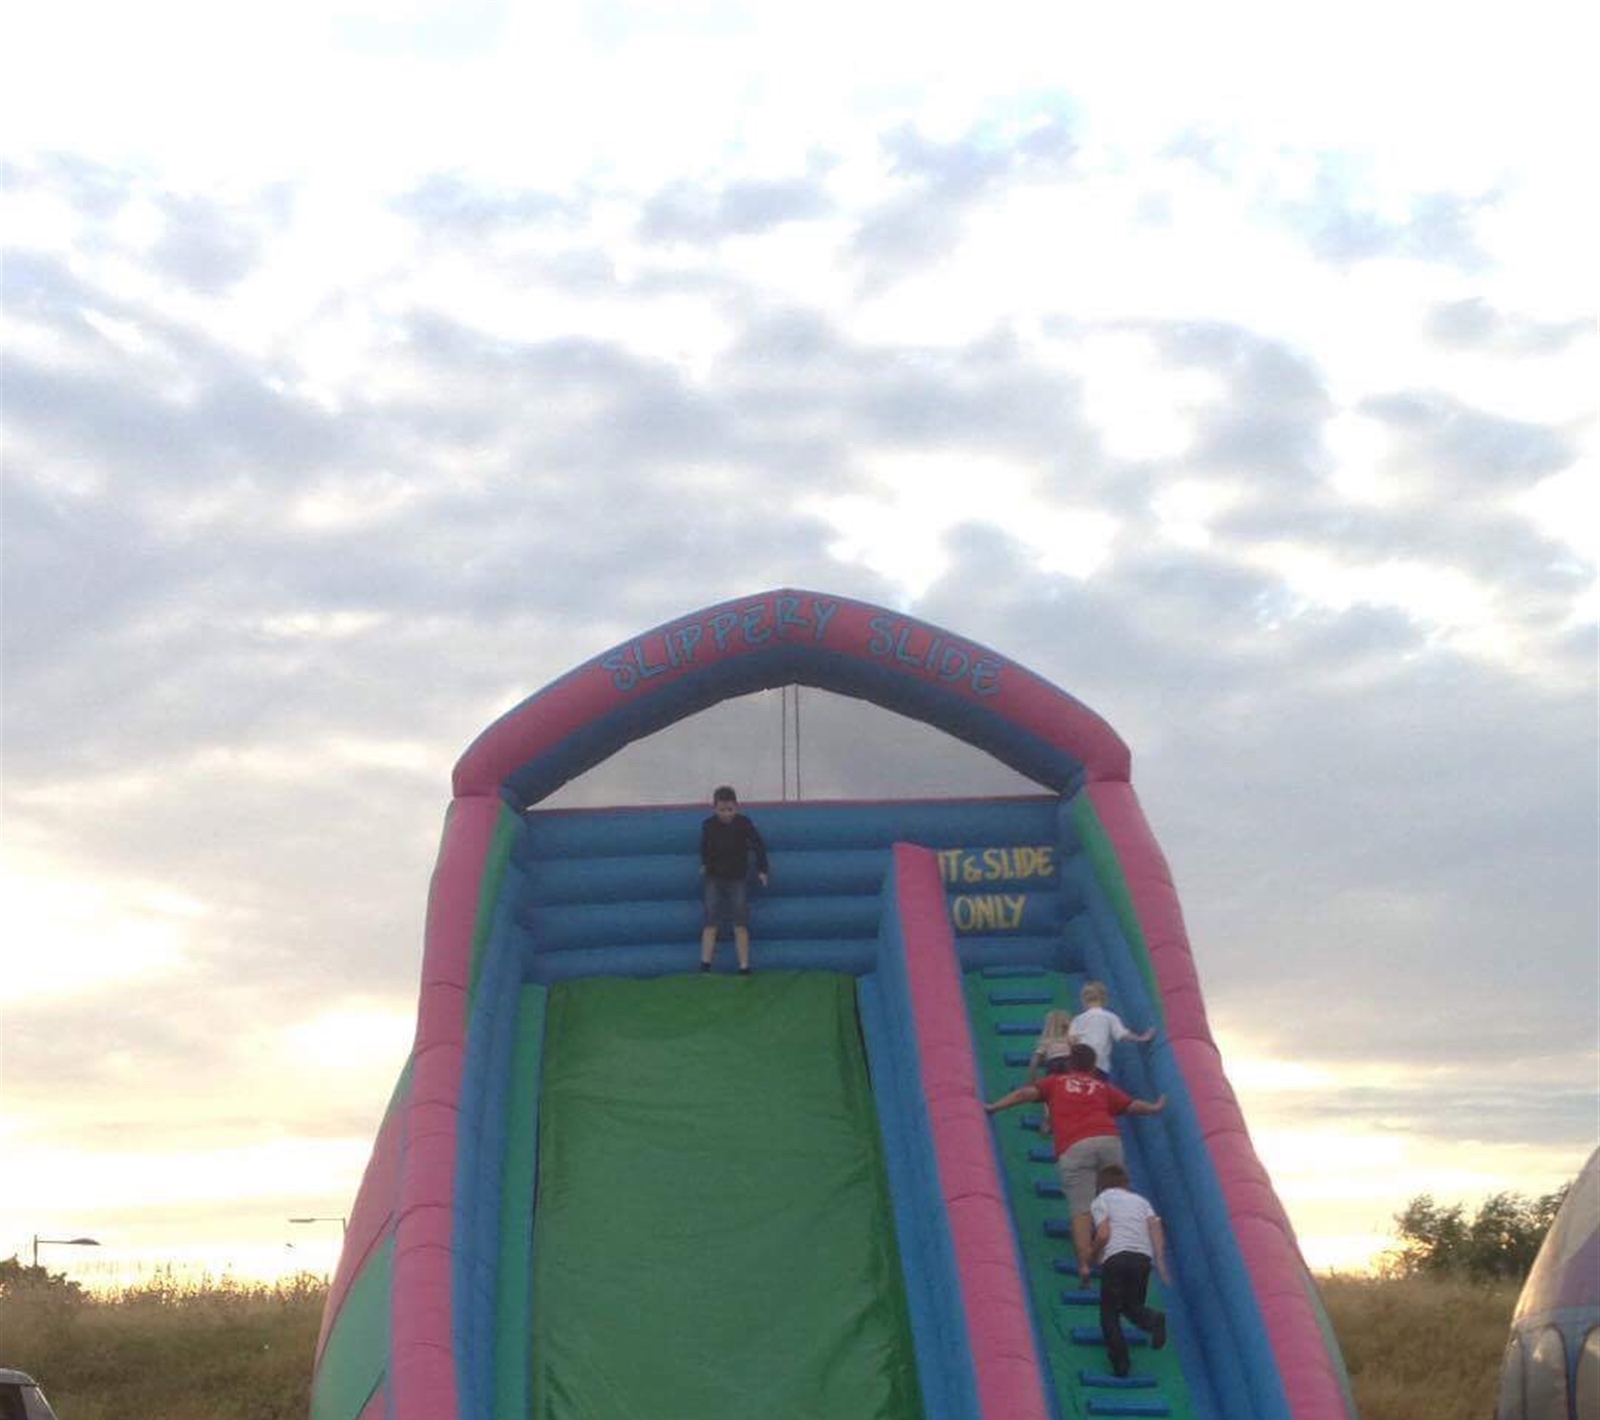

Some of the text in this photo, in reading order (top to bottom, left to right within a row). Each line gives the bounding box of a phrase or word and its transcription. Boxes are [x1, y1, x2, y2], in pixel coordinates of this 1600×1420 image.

[601, 599, 1001, 696] SLIPPERY SLIDE
[937, 848, 963, 883] IT
[952, 894, 1026, 930] ONLY
